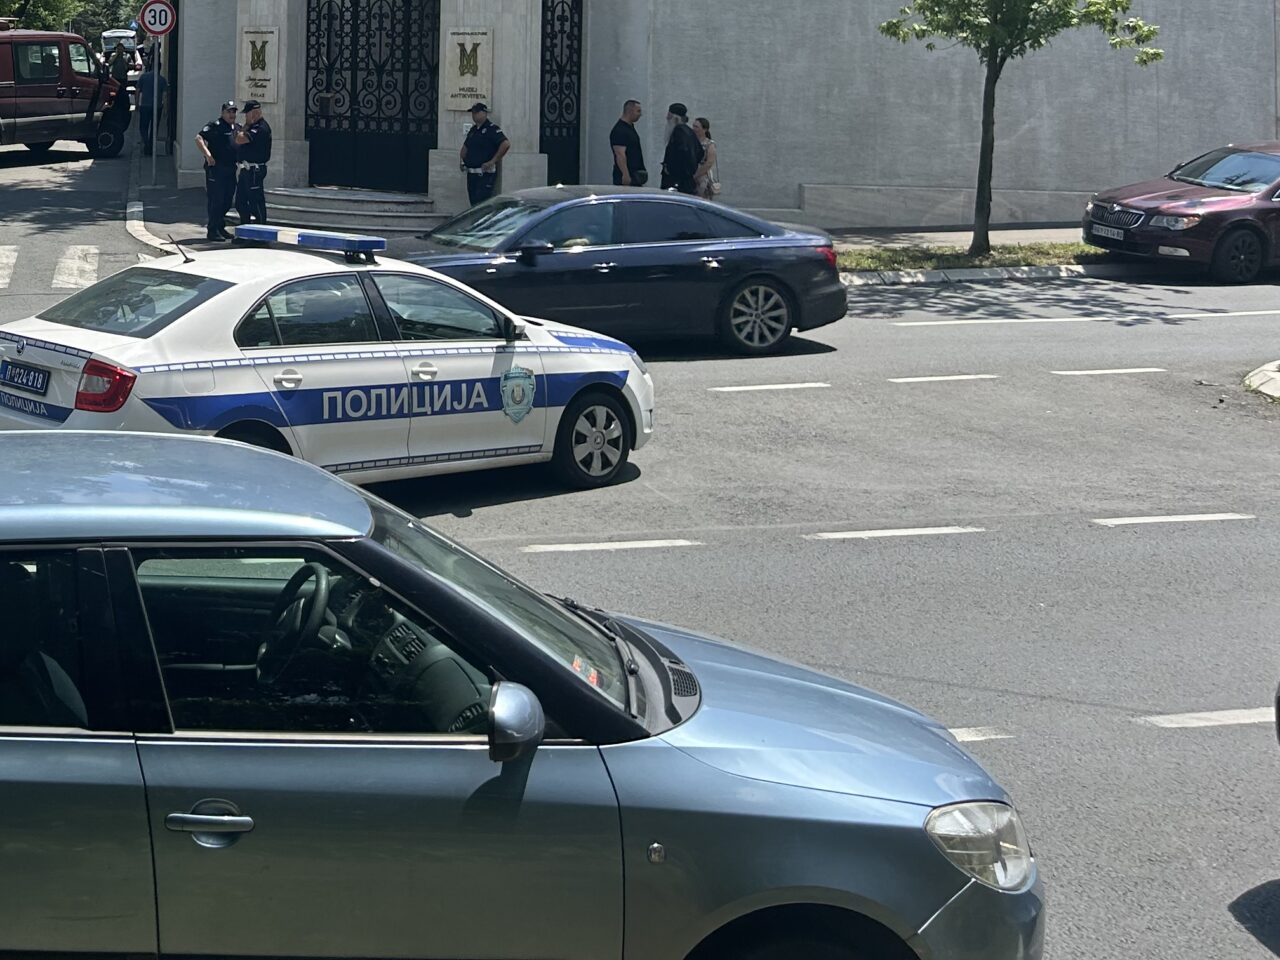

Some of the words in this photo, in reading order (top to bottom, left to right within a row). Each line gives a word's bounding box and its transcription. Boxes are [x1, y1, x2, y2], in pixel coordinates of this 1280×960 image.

[148, 8, 168, 26] 30
[0, 392, 48, 416] ПОЛИЦИЈА
[323, 382, 488, 419] ПОЛИЦИЈА
